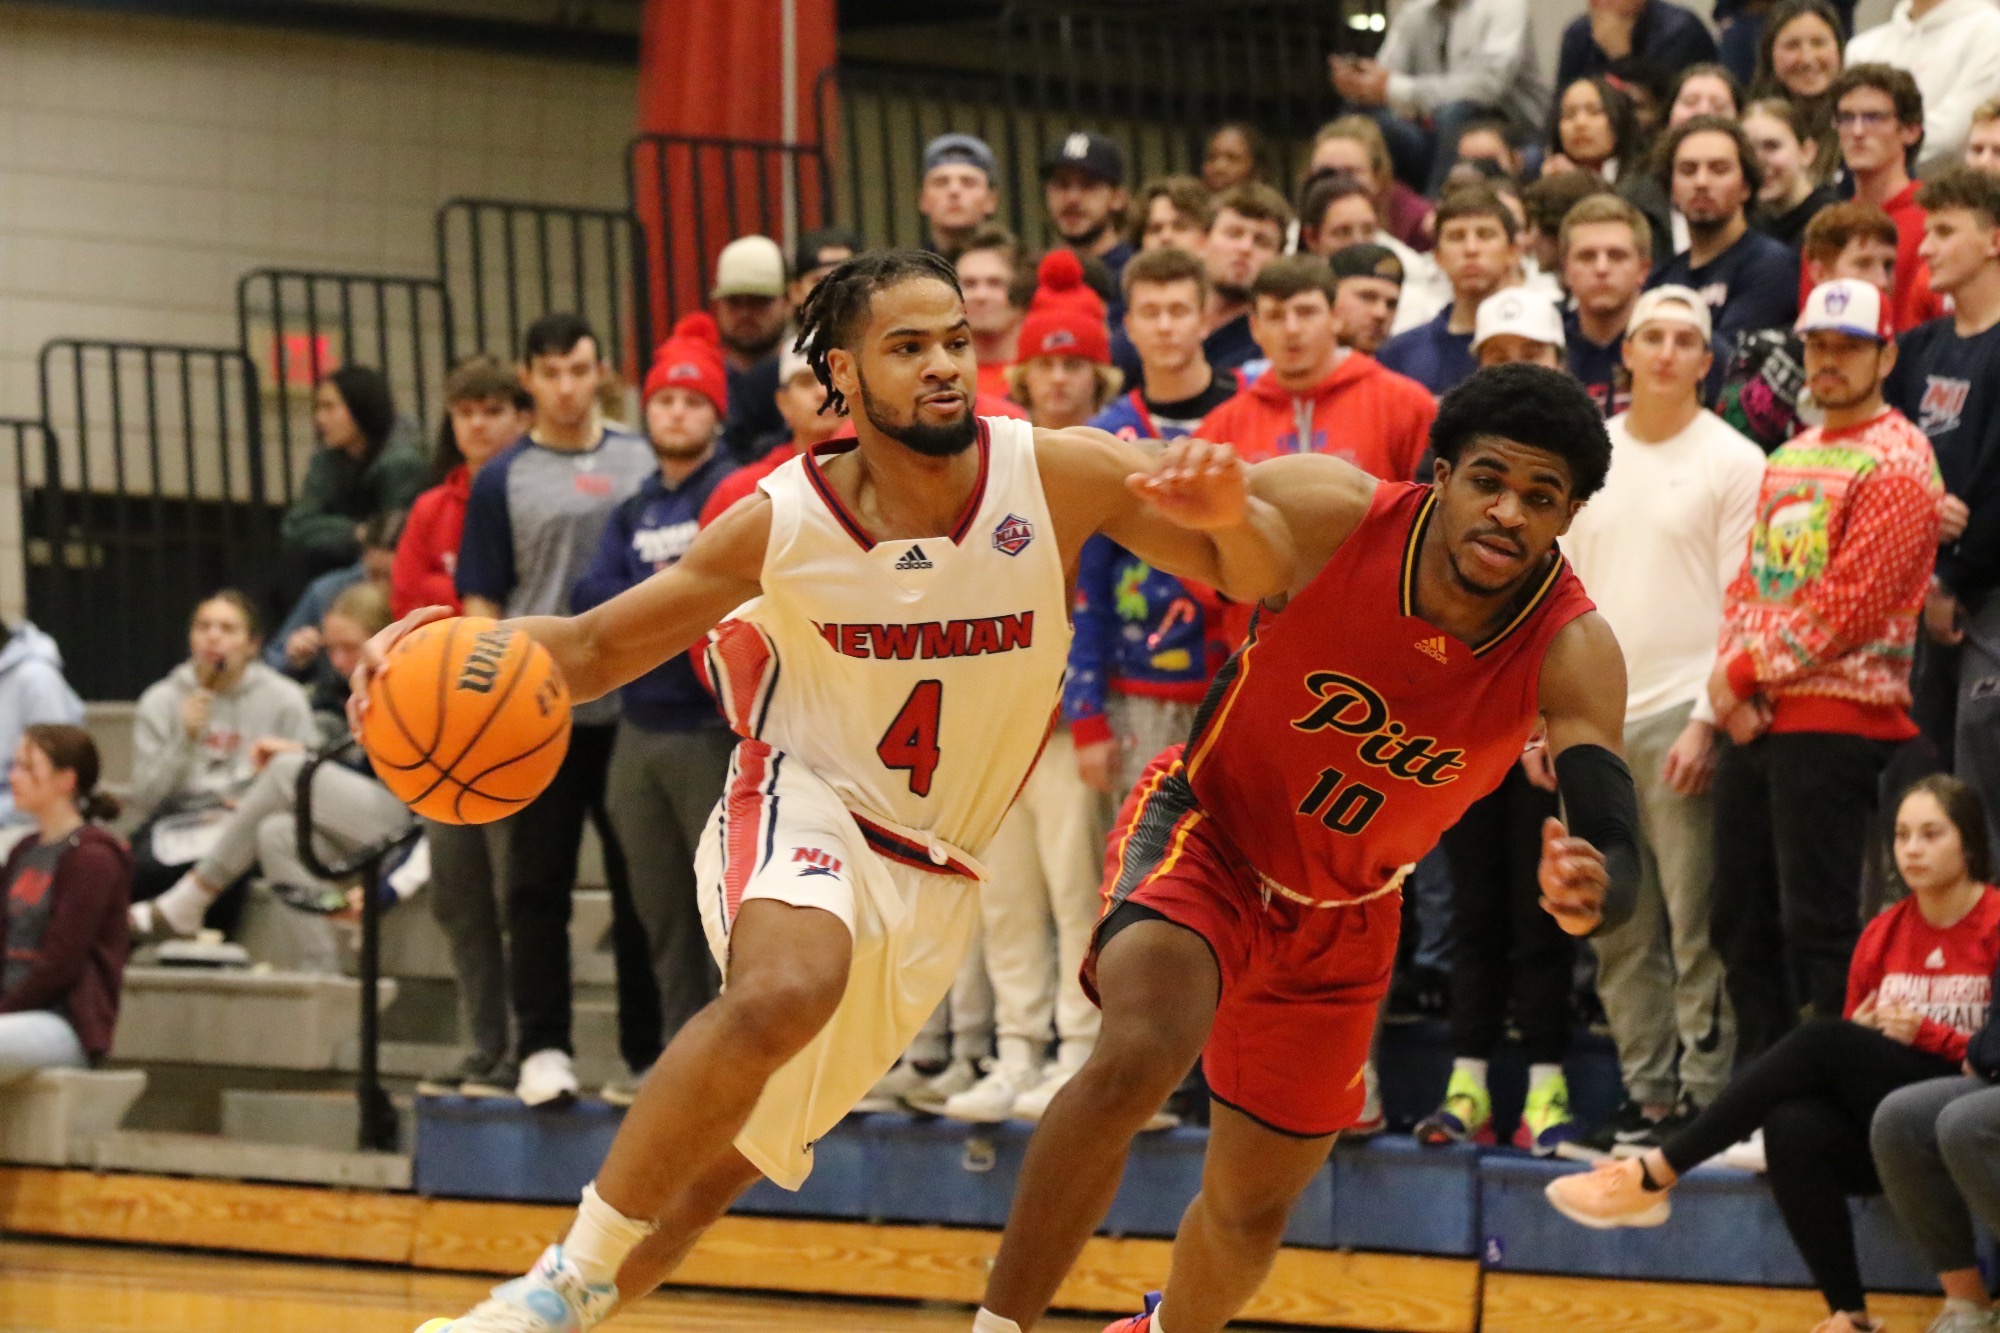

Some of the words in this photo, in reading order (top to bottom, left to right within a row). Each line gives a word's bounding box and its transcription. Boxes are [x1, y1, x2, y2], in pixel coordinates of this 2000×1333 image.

[1414, 641, 1448, 664] adidas
[876, 679, 942, 798] 4
[1290, 670, 1467, 787] Pitt
[1296, 766, 1386, 835] 10
